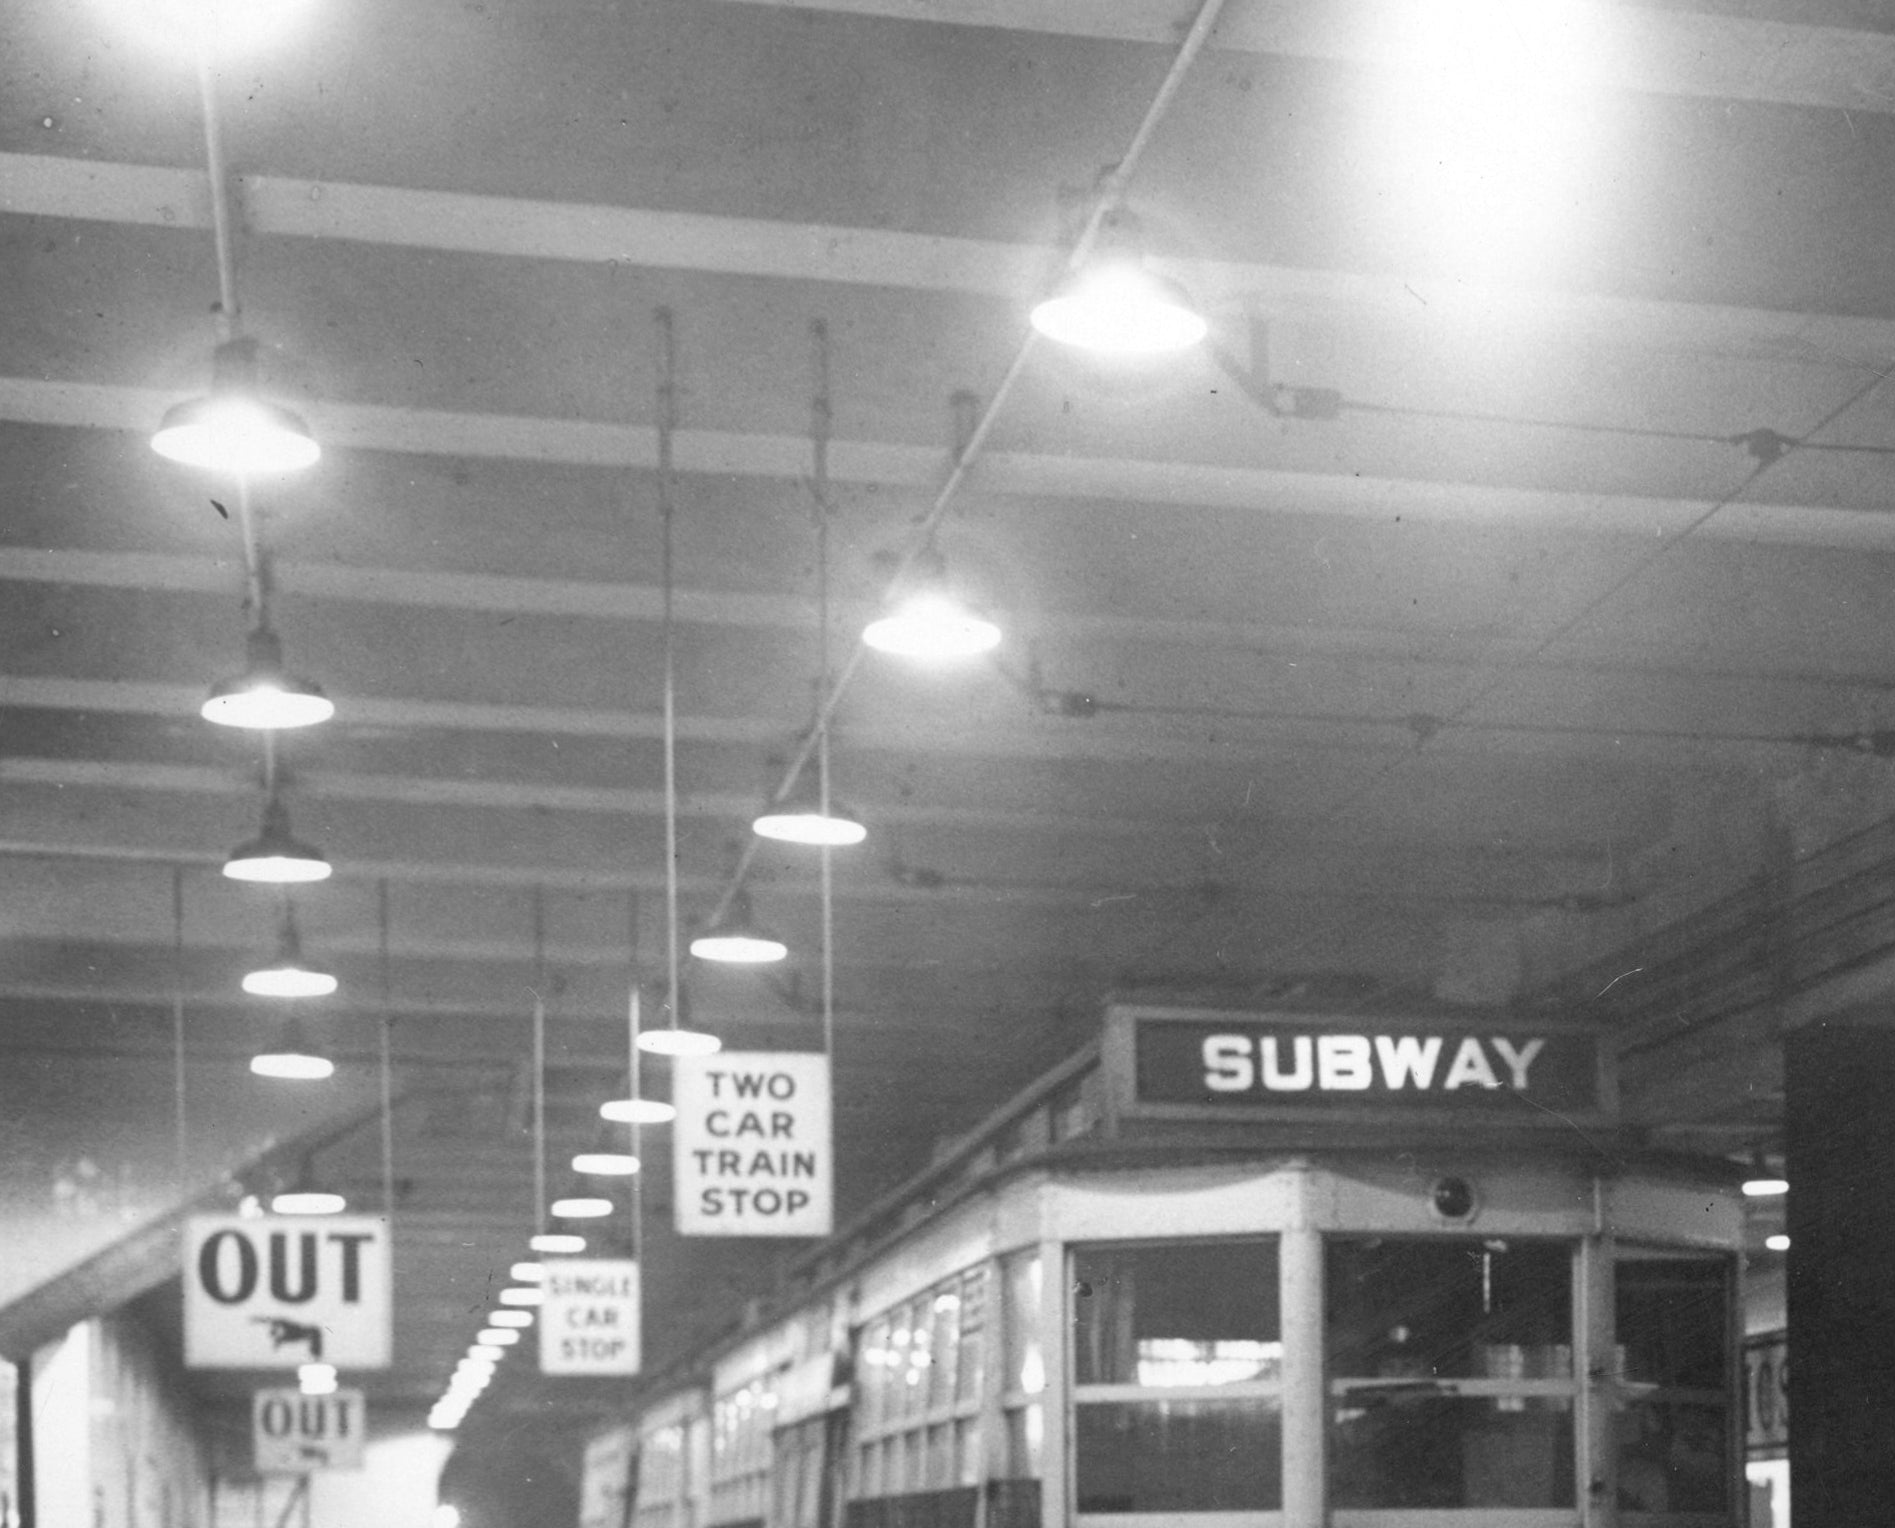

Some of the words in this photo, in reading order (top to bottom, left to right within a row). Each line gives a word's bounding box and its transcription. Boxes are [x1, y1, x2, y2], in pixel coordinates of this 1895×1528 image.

[1203, 1034, 1546, 1092] SUBWAY
[706, 1071, 796, 1101] TWO
[705, 1111, 795, 1140] CAR
[692, 1150, 816, 1179] TRAIN
[701, 1188, 810, 1217] STOP
[200, 1229, 375, 1306] OUT
[549, 1274, 633, 1299] SINGLE
[566, 1308, 620, 1331] CAR
[560, 1336, 626, 1360] STOP
[261, 1399, 353, 1441] OUT
